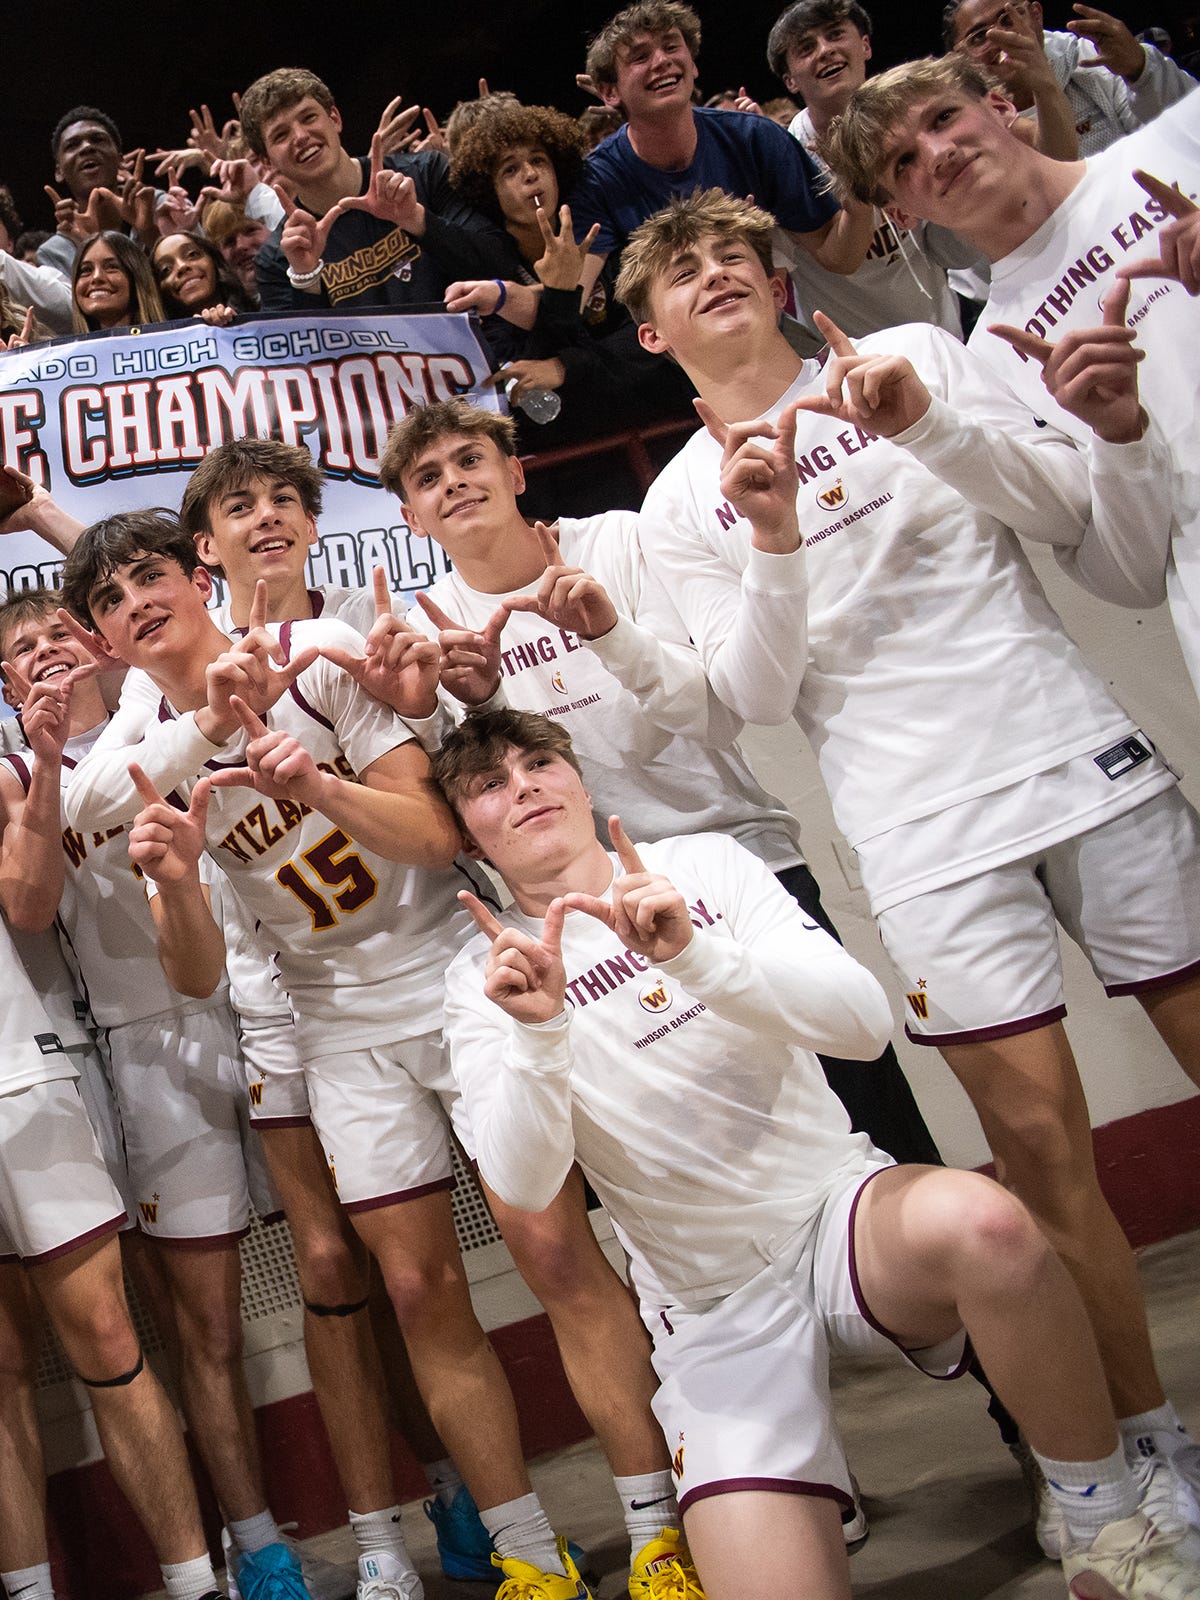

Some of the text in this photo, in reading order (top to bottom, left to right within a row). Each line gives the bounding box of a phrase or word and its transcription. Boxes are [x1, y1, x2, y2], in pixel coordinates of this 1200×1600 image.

[1111, 181, 1197, 252] EAS.
[113, 338, 219, 376] HIGH
[233, 328, 409, 361] SCHOOL
[843, 492, 894, 527] BASKETBALL
[544, 704, 571, 718] INDSOR
[275, 826, 379, 932] 15
[564, 950, 649, 1010] THING
[633, 1003, 708, 1050] WINDSOR BASKETB
[905, 992, 929, 1020] W
[138, 1202, 158, 1224] W
